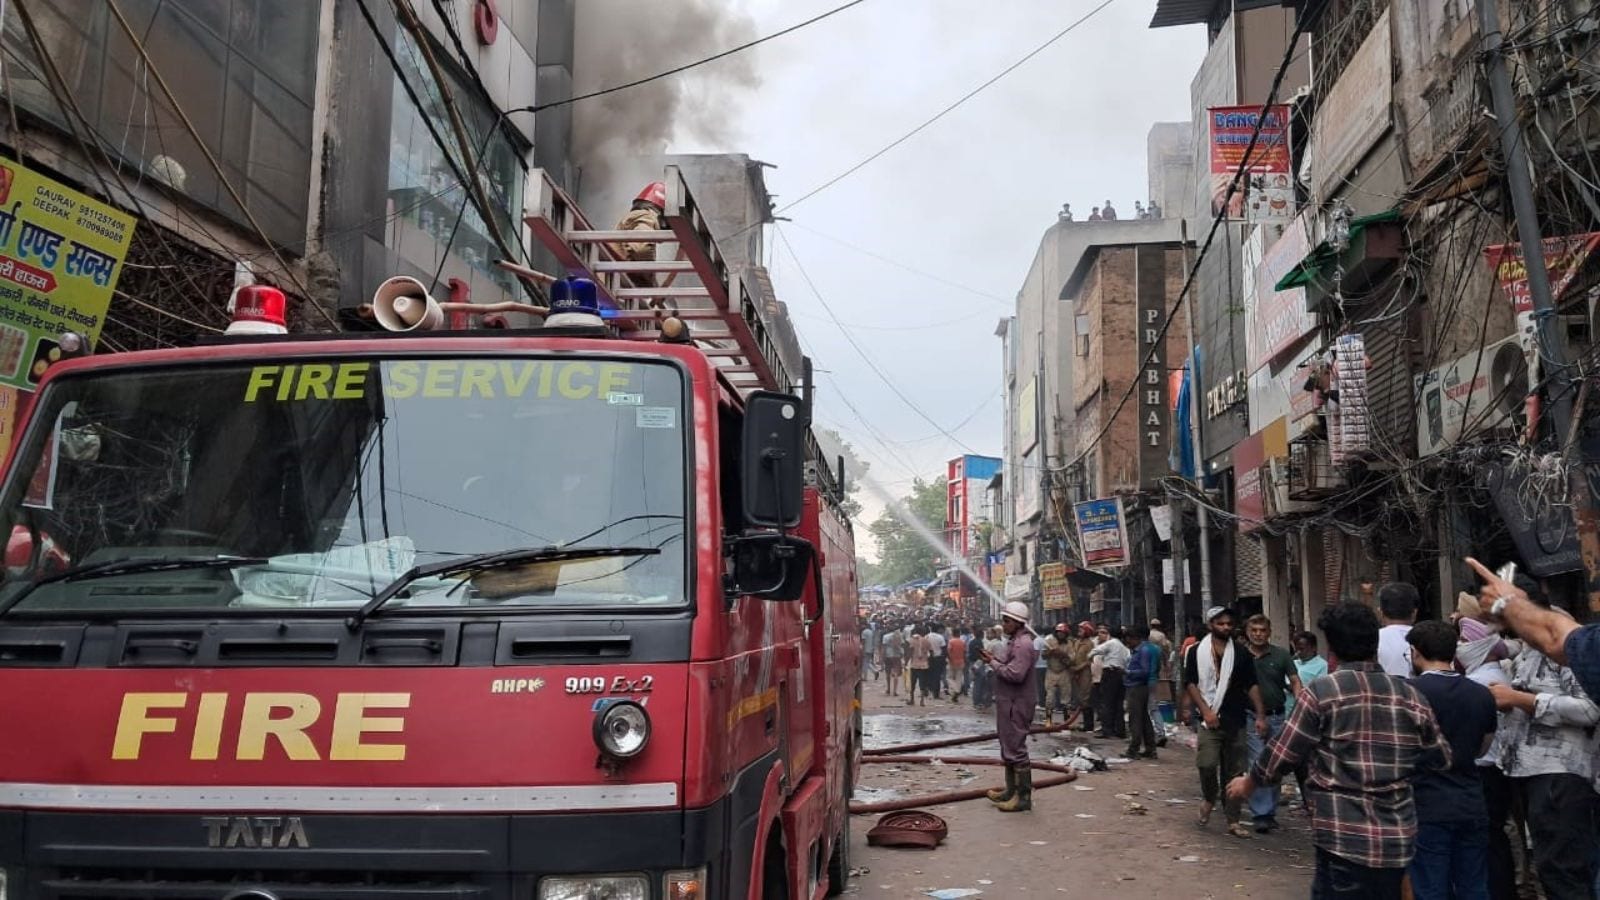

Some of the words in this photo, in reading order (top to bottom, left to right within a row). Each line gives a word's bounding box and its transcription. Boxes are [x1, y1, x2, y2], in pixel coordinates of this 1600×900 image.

[33, 197, 71, 221] DEEPAK
[37, 185, 76, 209] GAURAV
[17, 219, 65, 269] एण्ड
[65, 240, 117, 287] सन्स
[244, 362, 370, 403] FIRE
[385, 361, 632, 400] SERVICE
[1146, 310, 1160, 446] PRABHAT
[111, 692, 411, 762] FIRE
[200, 816, 309, 848] TATA
